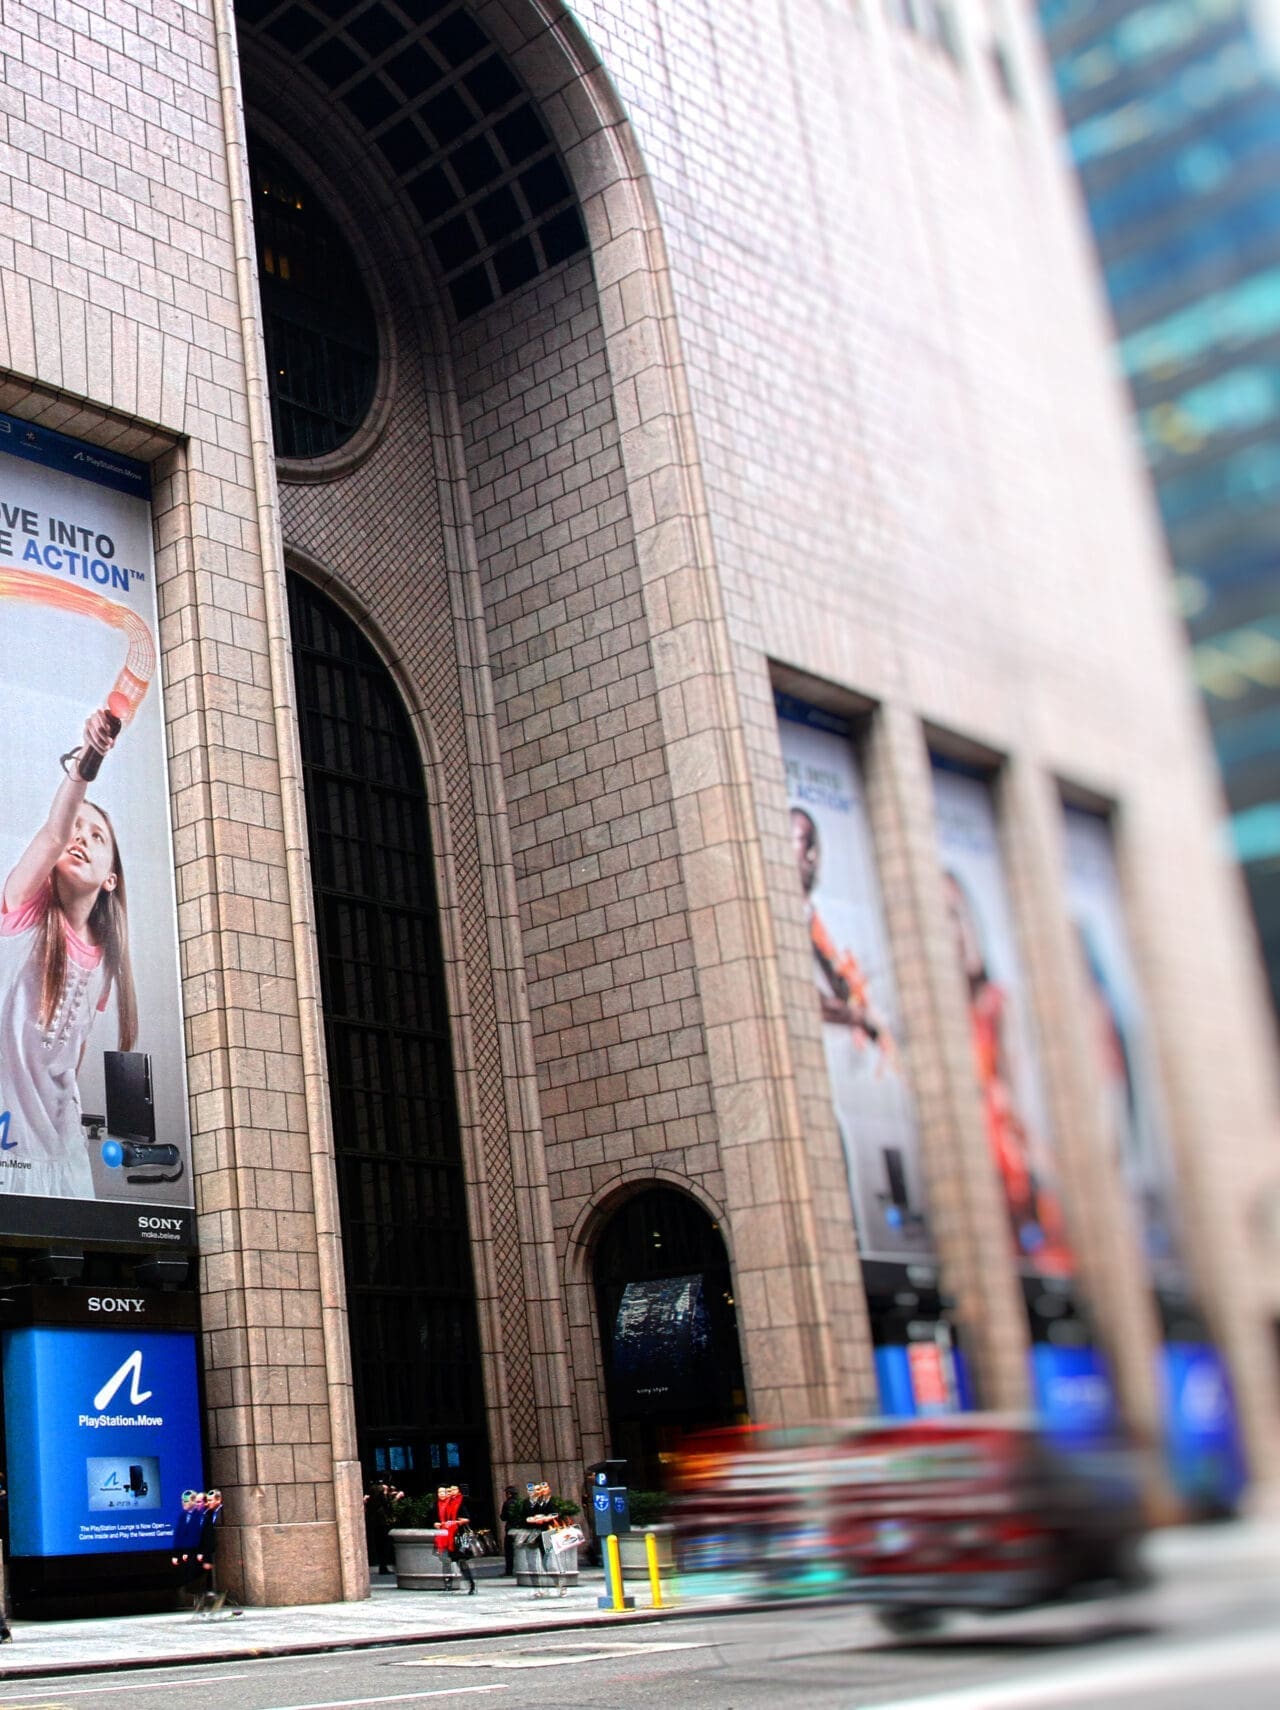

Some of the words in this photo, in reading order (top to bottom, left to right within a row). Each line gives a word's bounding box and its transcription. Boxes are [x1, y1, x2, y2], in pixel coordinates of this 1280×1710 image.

[49, 517, 114, 558] INTO
[138, 1216, 183, 1230] SONY
[87, 1296, 145, 1312] SONY
[598, 1472, 607, 1485] P
[117, 1523, 135, 1531] Lounge
